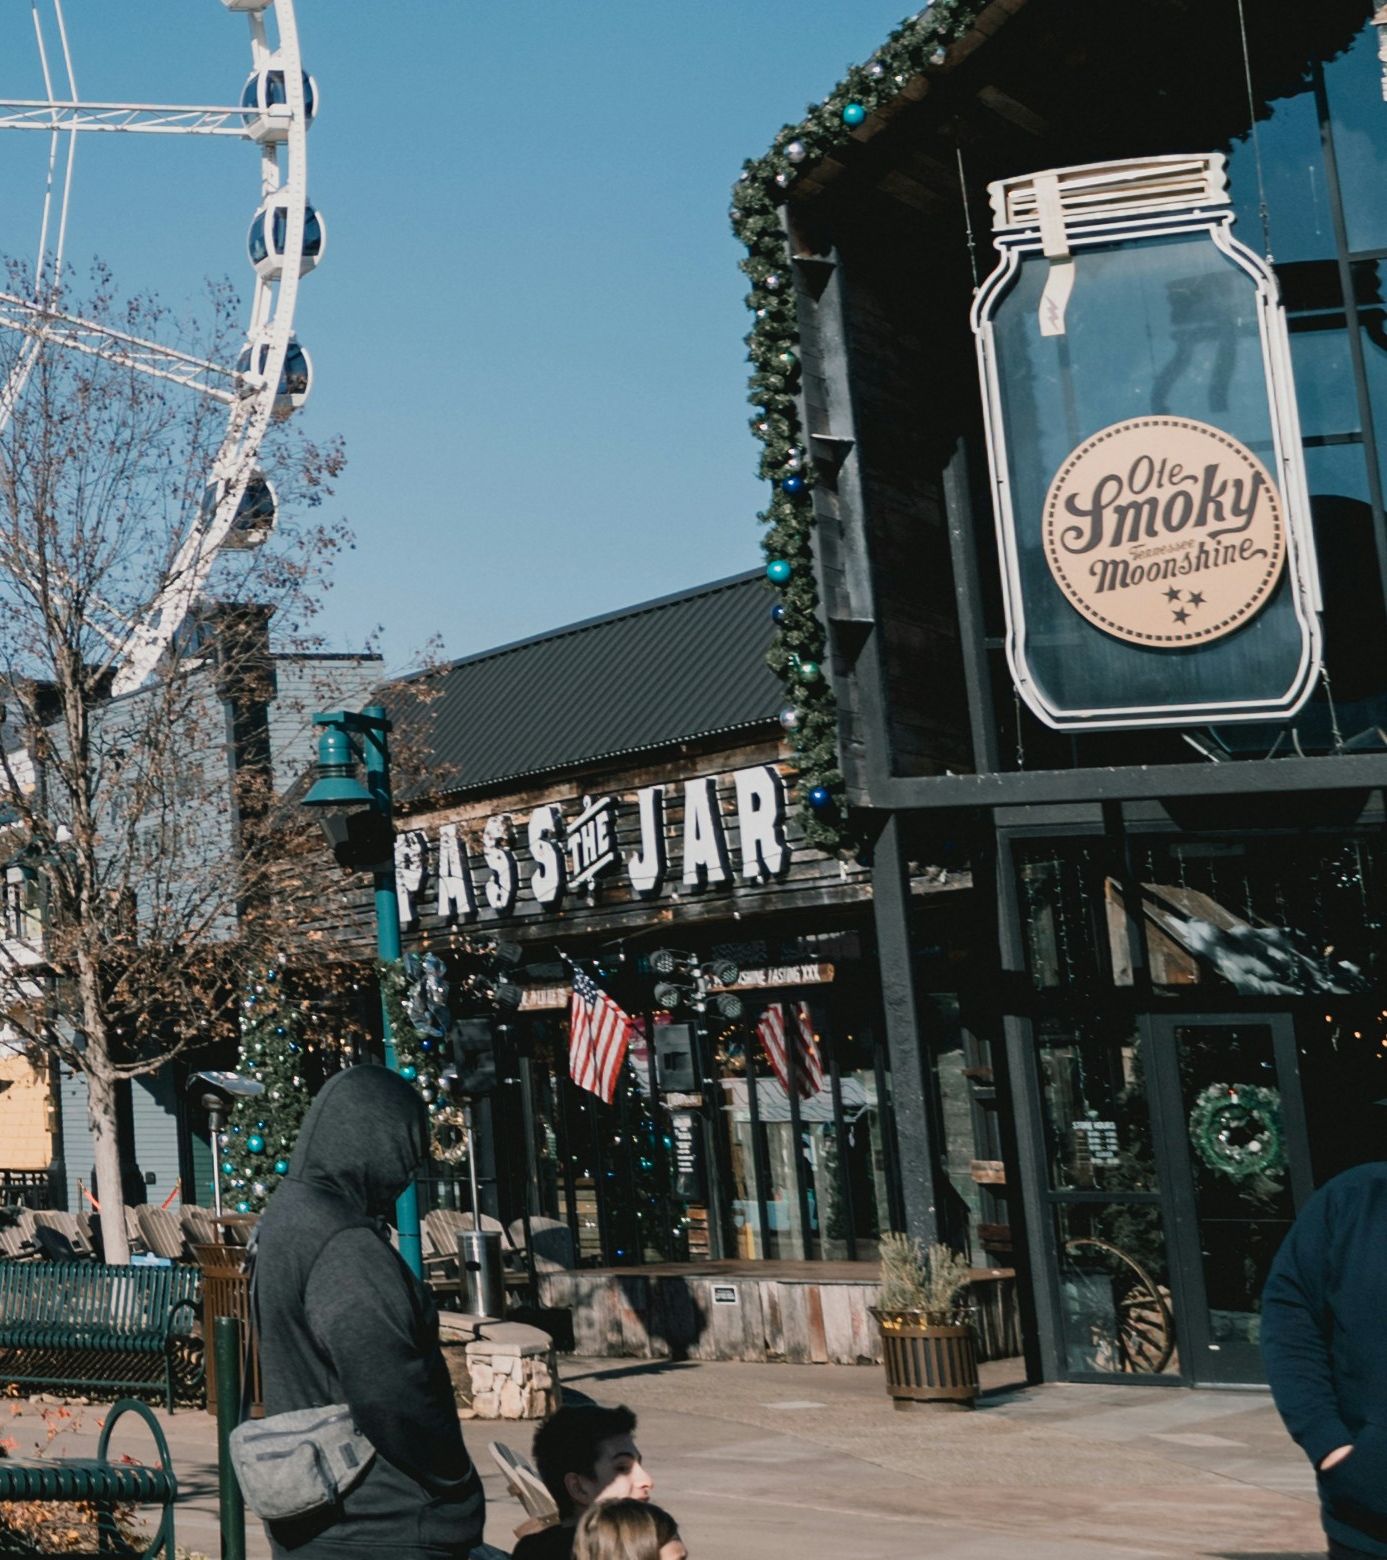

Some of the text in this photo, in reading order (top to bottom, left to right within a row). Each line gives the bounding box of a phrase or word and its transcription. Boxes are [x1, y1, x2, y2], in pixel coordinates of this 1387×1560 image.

[1128, 455, 1199, 495] Ole
[1060, 462, 1267, 555] Smoky
[1088, 537, 1269, 594] Moonshine
[1128, 538, 1196, 561] Tennessee
[394, 764, 784, 923] PASS THE JAR
